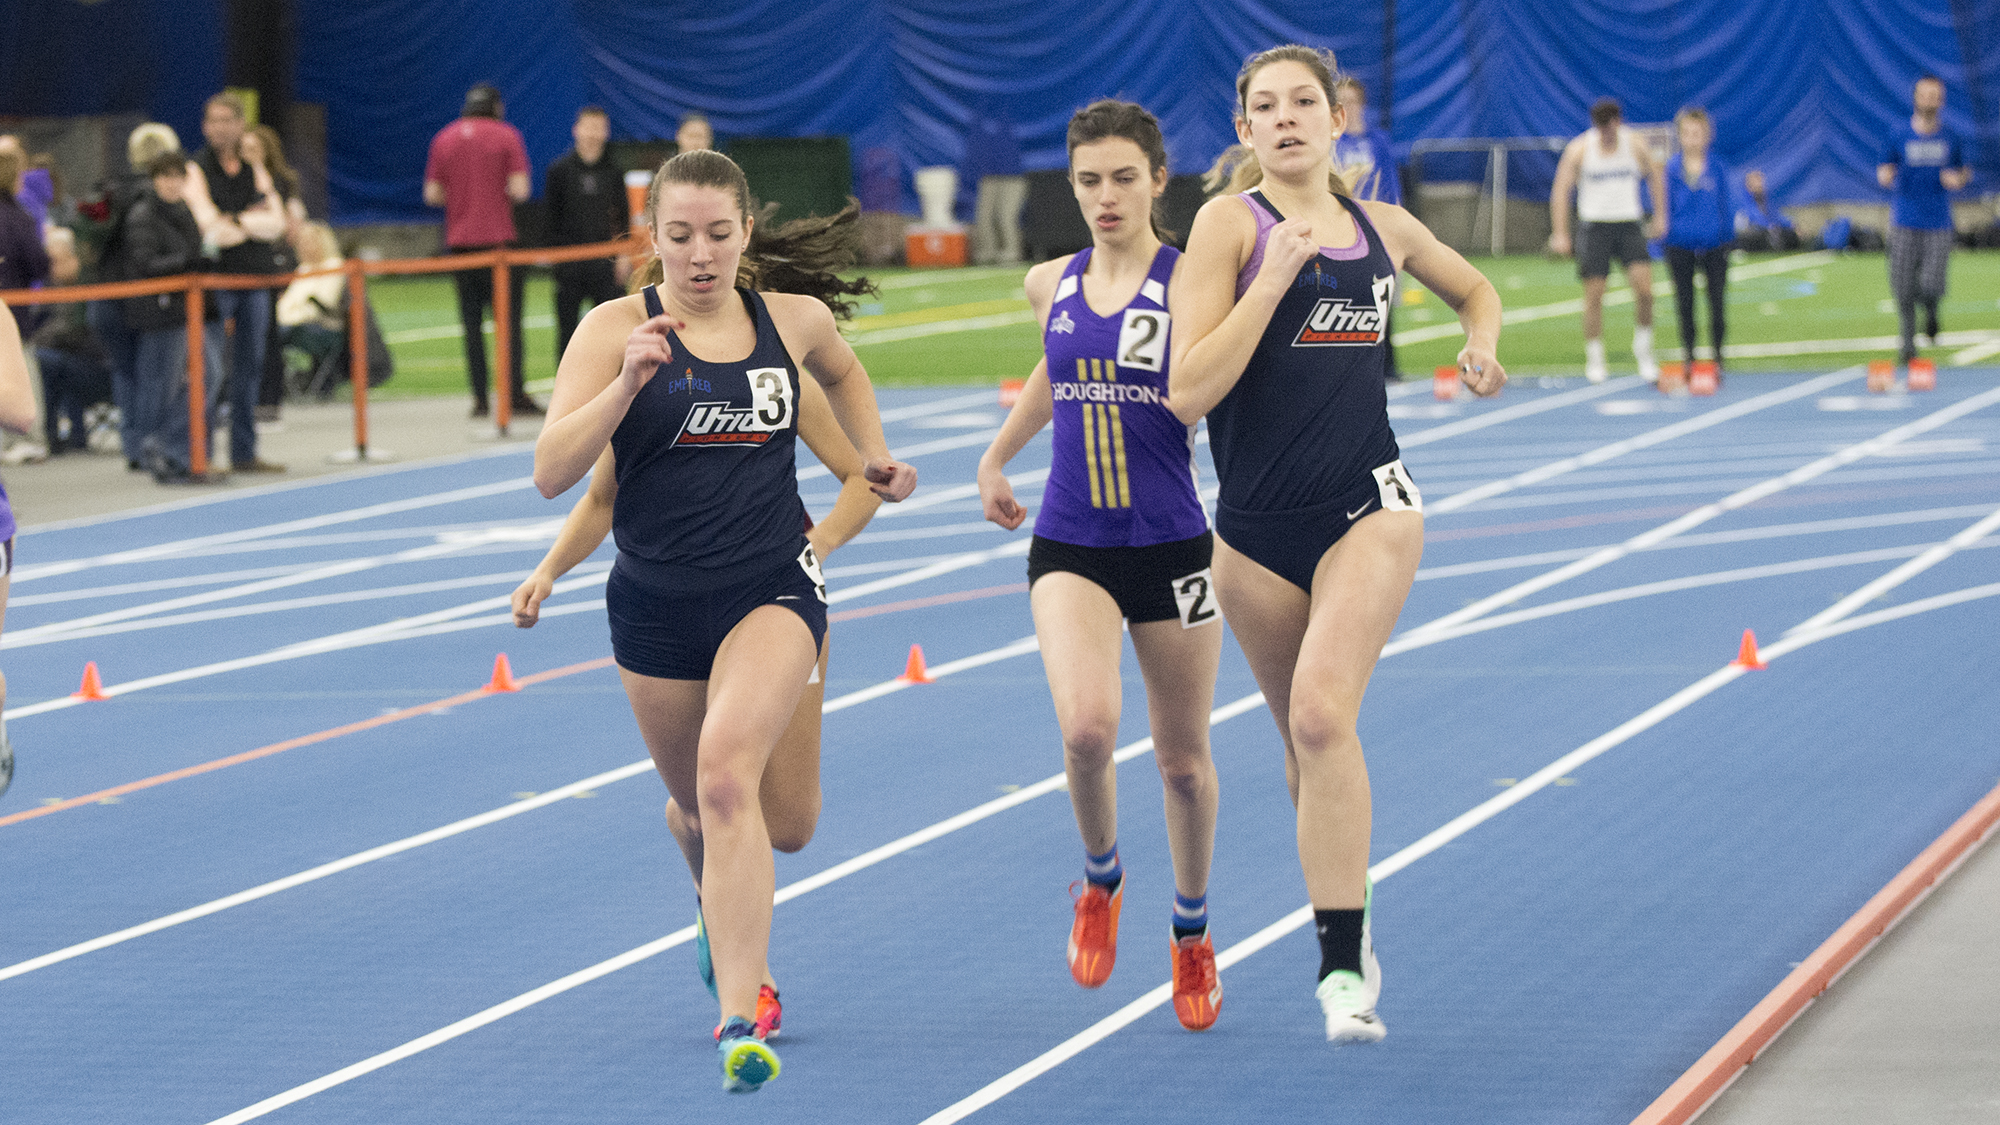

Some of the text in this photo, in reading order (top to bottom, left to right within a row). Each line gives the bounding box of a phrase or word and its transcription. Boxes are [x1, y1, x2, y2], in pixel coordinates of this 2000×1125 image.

[1124, 315, 1159, 365] 2
[756, 371, 787, 426] 3
[1052, 382, 1160, 404] HOUGHTON
[686, 406, 773, 434] UTIC
[1383, 467, 1413, 507] 1
[1181, 576, 1215, 624] 2
